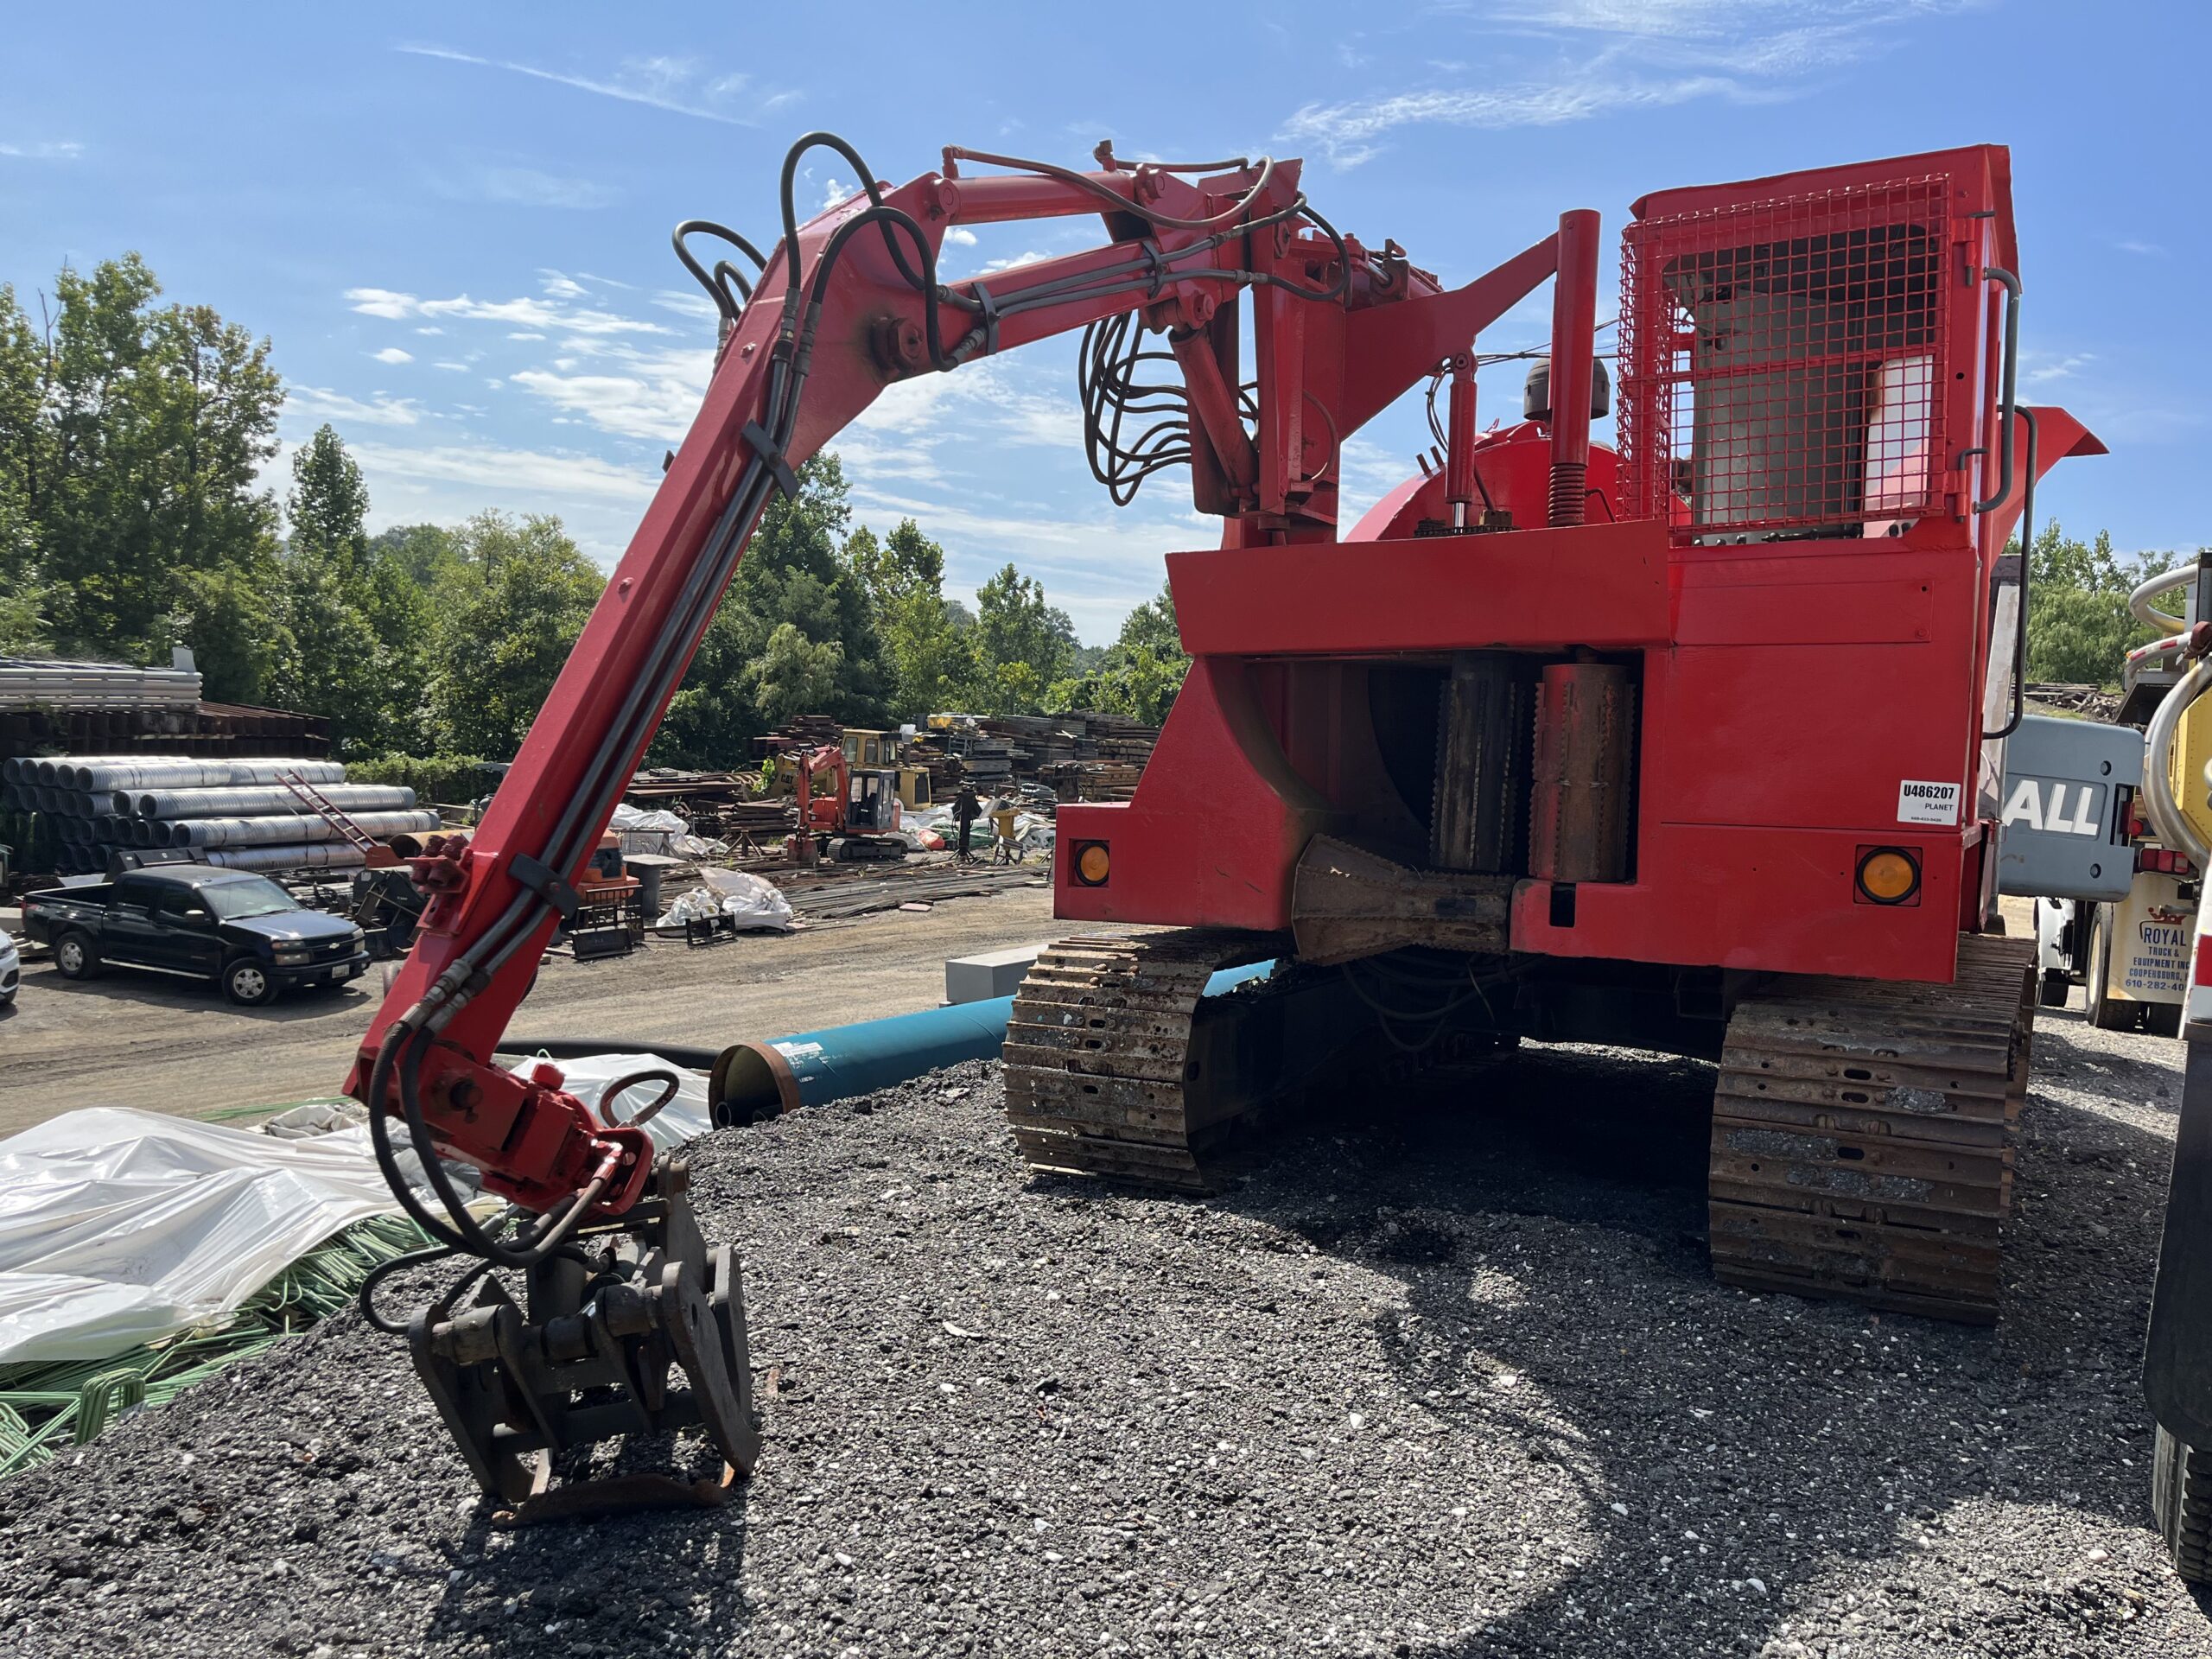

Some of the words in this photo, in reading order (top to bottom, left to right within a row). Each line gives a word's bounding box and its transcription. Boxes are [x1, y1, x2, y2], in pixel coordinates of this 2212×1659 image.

[1904, 785, 1955, 799] U486207
[1924, 803, 1955, 811] PLANET
[2144, 927, 2186, 946] ROYAL
[2148, 946, 2172, 957] TRUCK
[2173, 949, 2180, 957] &
[2133, 957, 2177, 969] EQUIPMENT
[2126, 979, 2186, 991] 610-282-40
